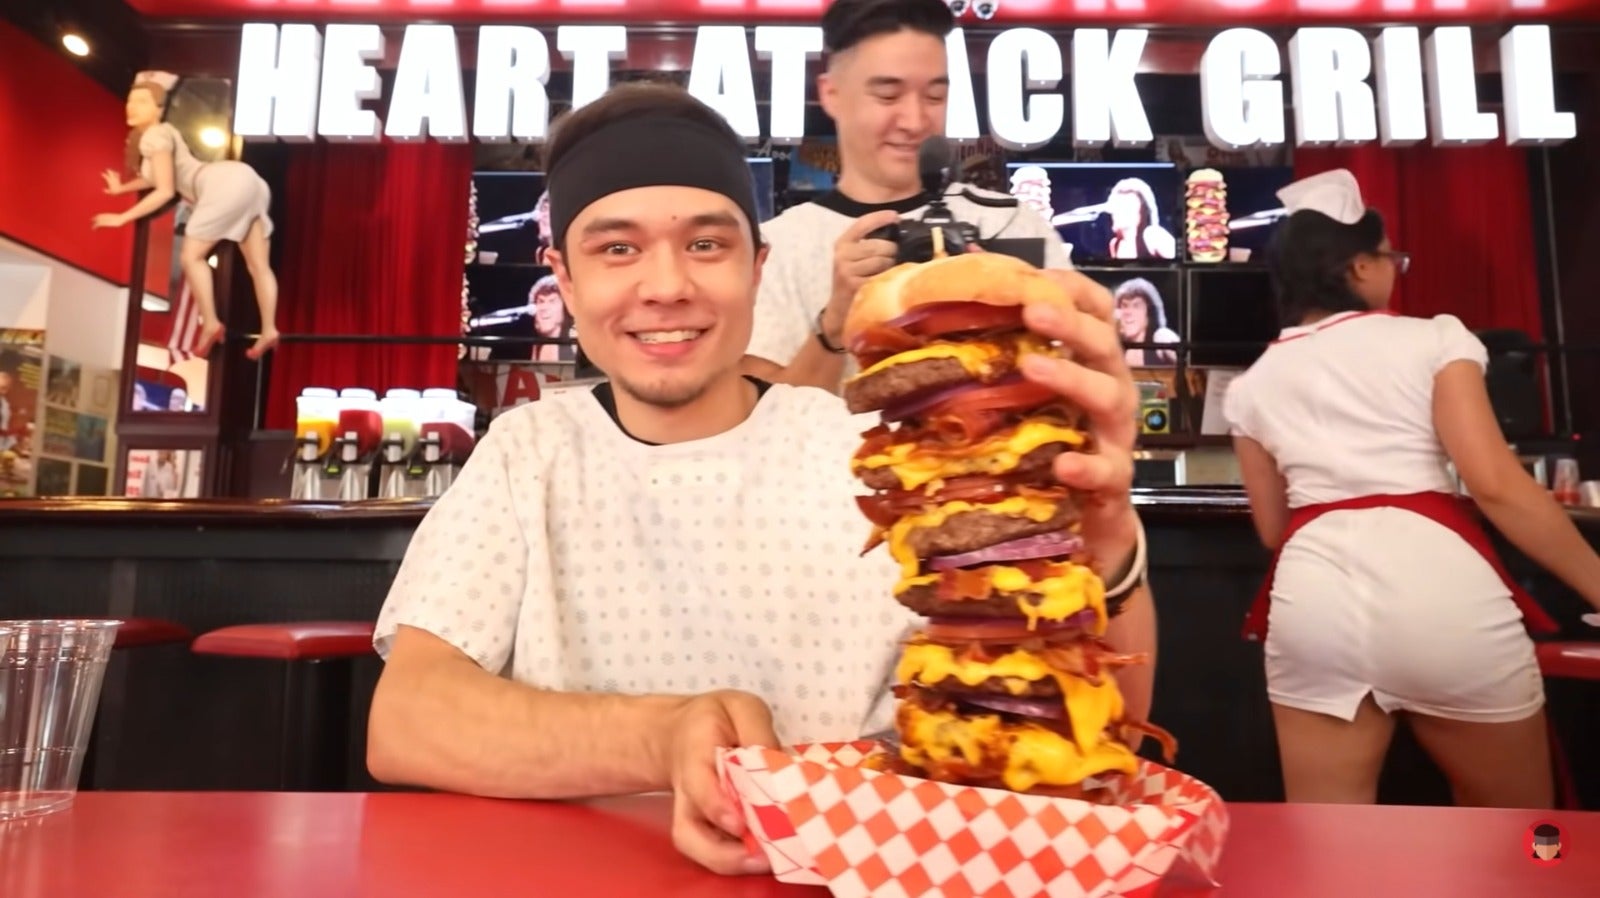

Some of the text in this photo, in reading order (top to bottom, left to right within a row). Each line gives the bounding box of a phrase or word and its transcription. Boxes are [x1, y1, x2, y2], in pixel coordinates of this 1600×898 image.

[234, 22, 1577, 149] HEART ATCK GRILL
